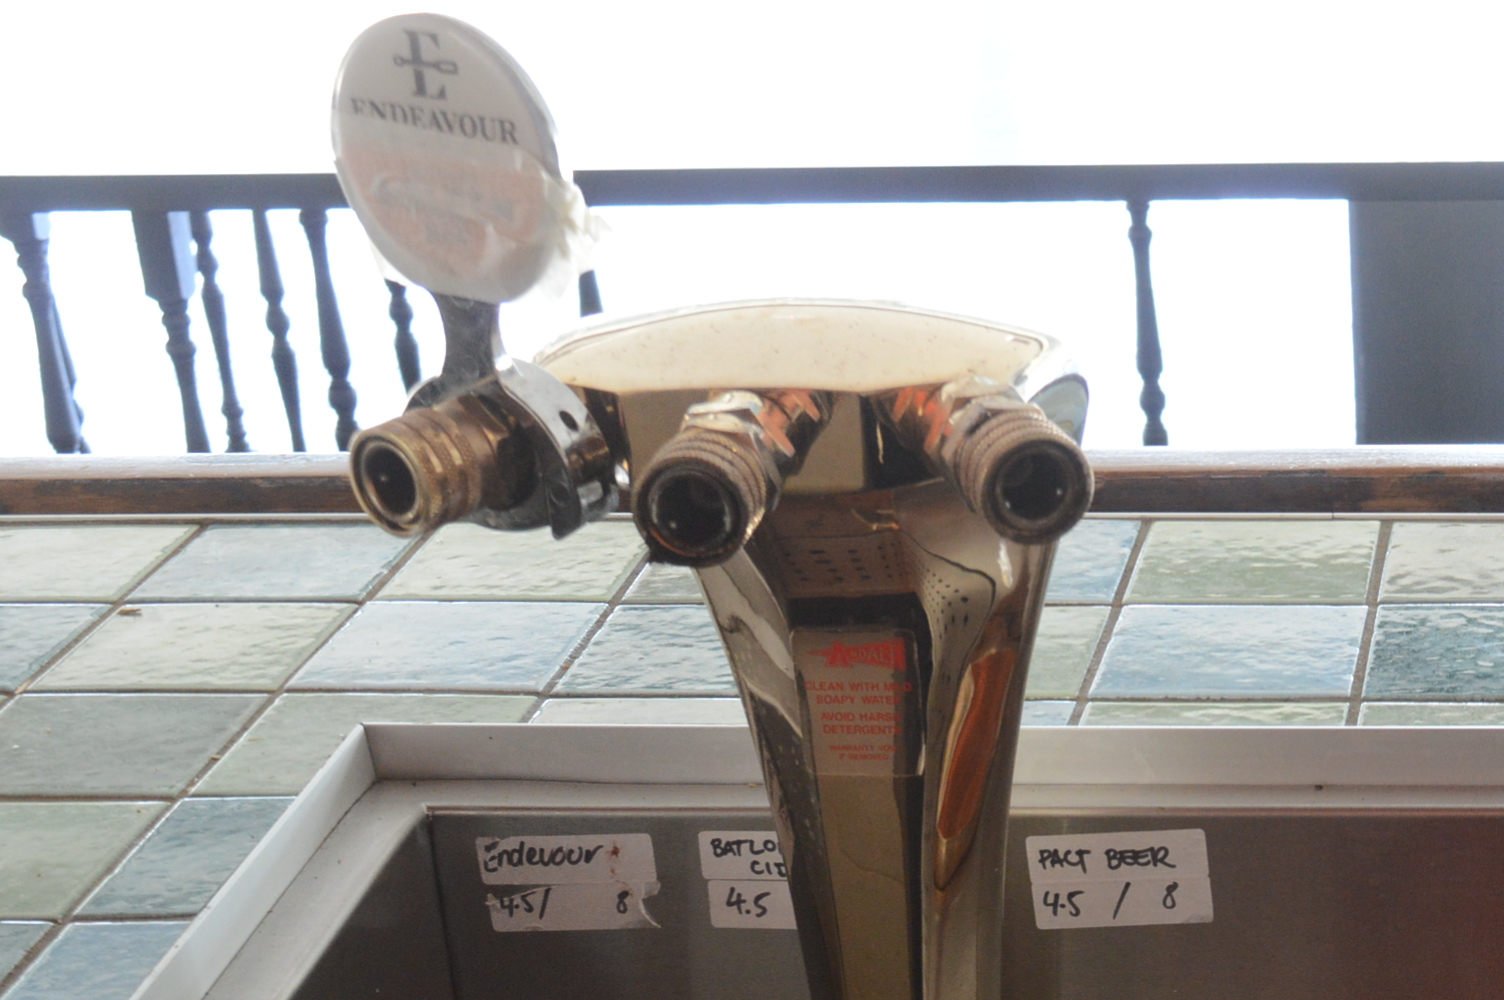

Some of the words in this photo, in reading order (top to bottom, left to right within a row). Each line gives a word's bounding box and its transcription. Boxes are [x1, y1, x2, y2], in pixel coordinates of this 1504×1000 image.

[350, 98, 520, 146] ENDEAVOUR
[804, 681, 845, 692] CLEAN
[848, 681, 880, 692] WITH
[816, 694, 856, 705] SOAPY
[862, 695, 902, 705] WATER
[821, 711, 856, 722] AVOID
[823, 725, 902, 736] DETERGENTS
[710, 837, 779, 858] BATLO
[1038, 848, 1091, 875] PACT
[1104, 845, 1177, 871] BEER
[615, 889, 631, 915] 8
[726, 886, 772, 918] 4.5
[1042, 889, 1086, 918] 4.5
[1162, 881, 1179, 910] 8
